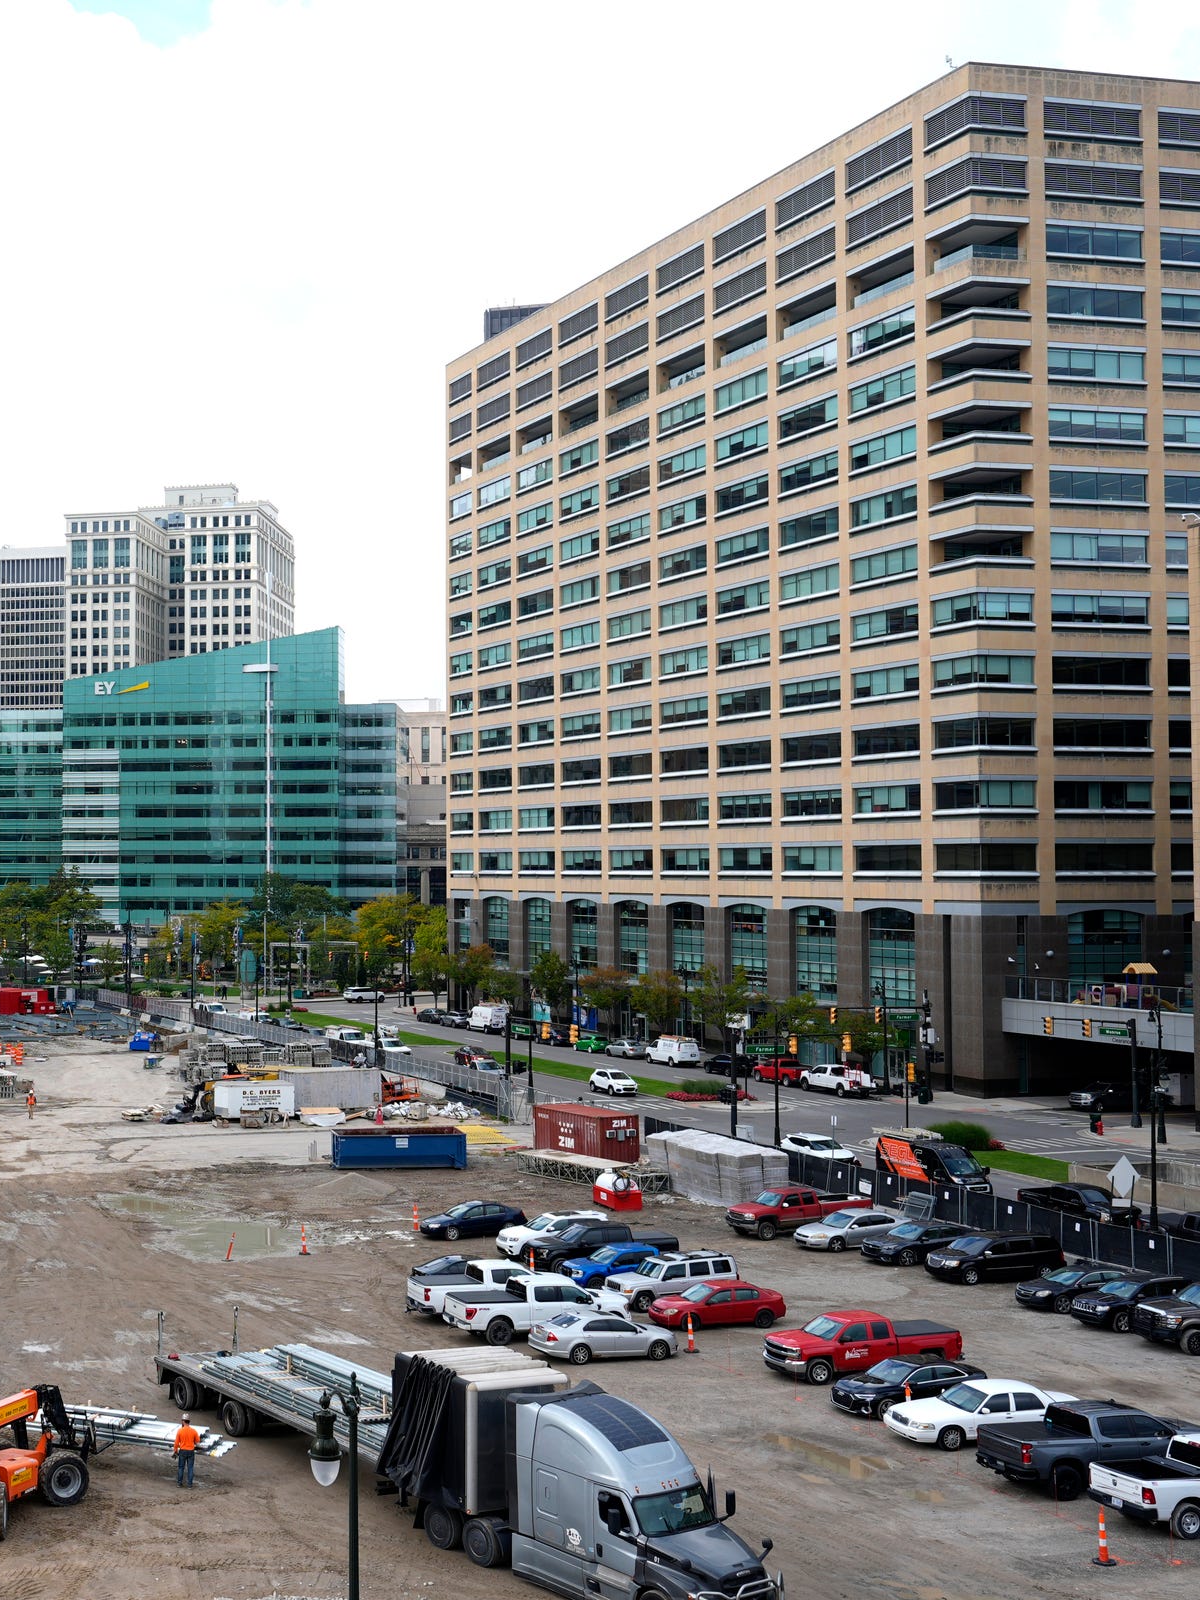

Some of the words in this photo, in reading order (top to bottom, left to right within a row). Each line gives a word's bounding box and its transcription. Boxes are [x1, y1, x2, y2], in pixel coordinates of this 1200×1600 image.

[94, 681, 115, 695] EY
[1112, 1037, 1132, 1045] Clearanc
[612, 1119, 627, 1128] ZIM
[558, 1135, 575, 1149] ZIM
